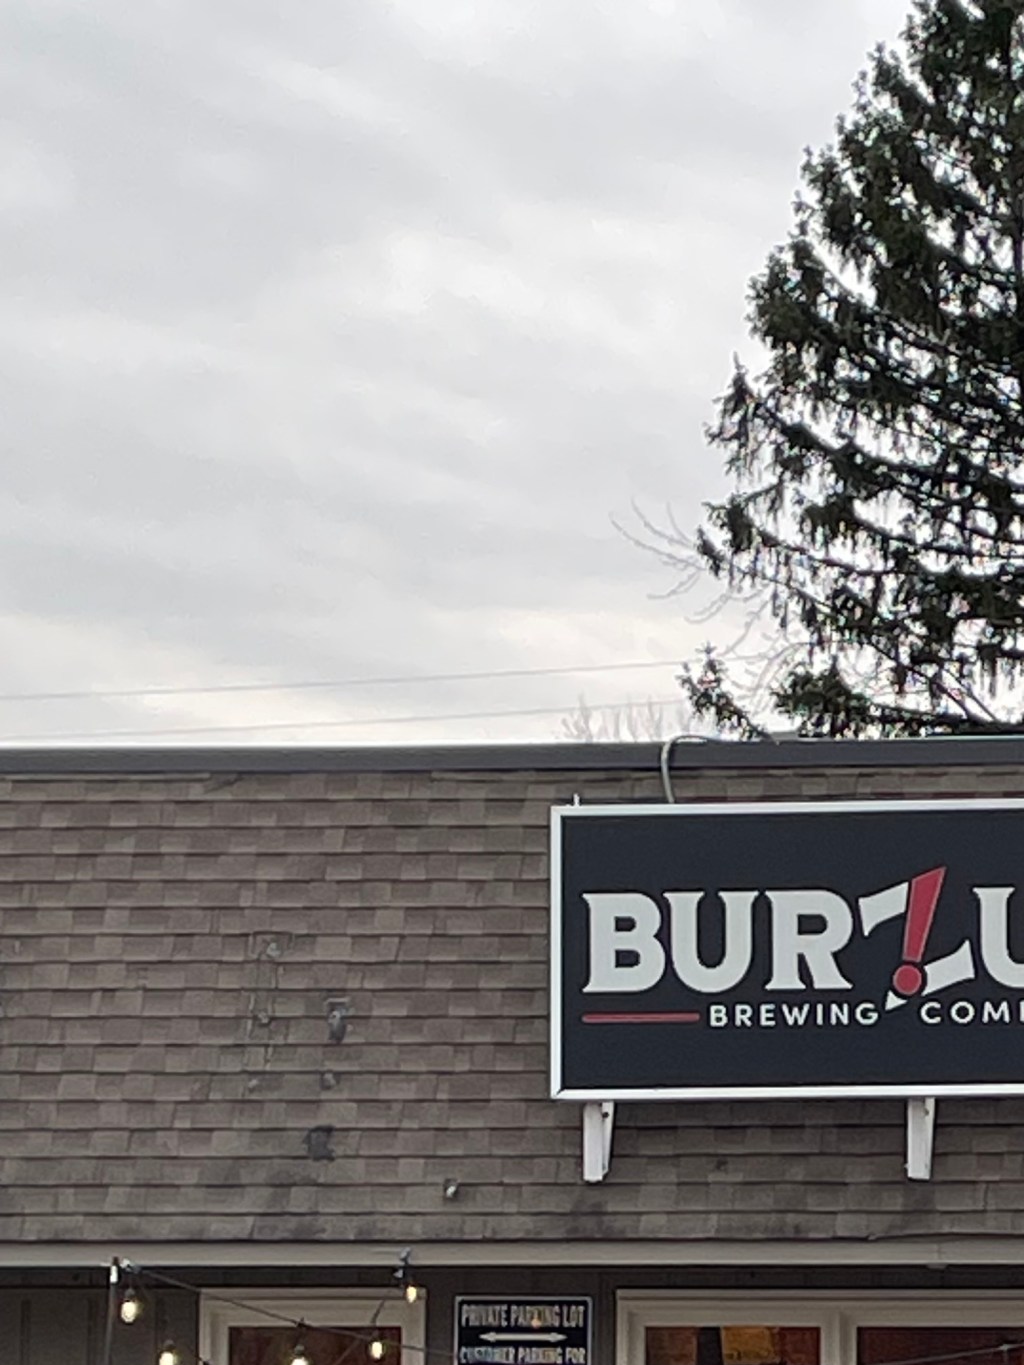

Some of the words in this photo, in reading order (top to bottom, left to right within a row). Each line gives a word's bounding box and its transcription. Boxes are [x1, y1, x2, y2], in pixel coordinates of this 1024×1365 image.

[709, 1002, 880, 1028] BREWING
[461, 1304, 508, 1328] PRIVATE
[510, 1304, 560, 1328] PARKING
[562, 1304, 585, 1328] LOT
[517, 1347, 562, 1364] PARKING
[565, 1347, 586, 1364] FOR
